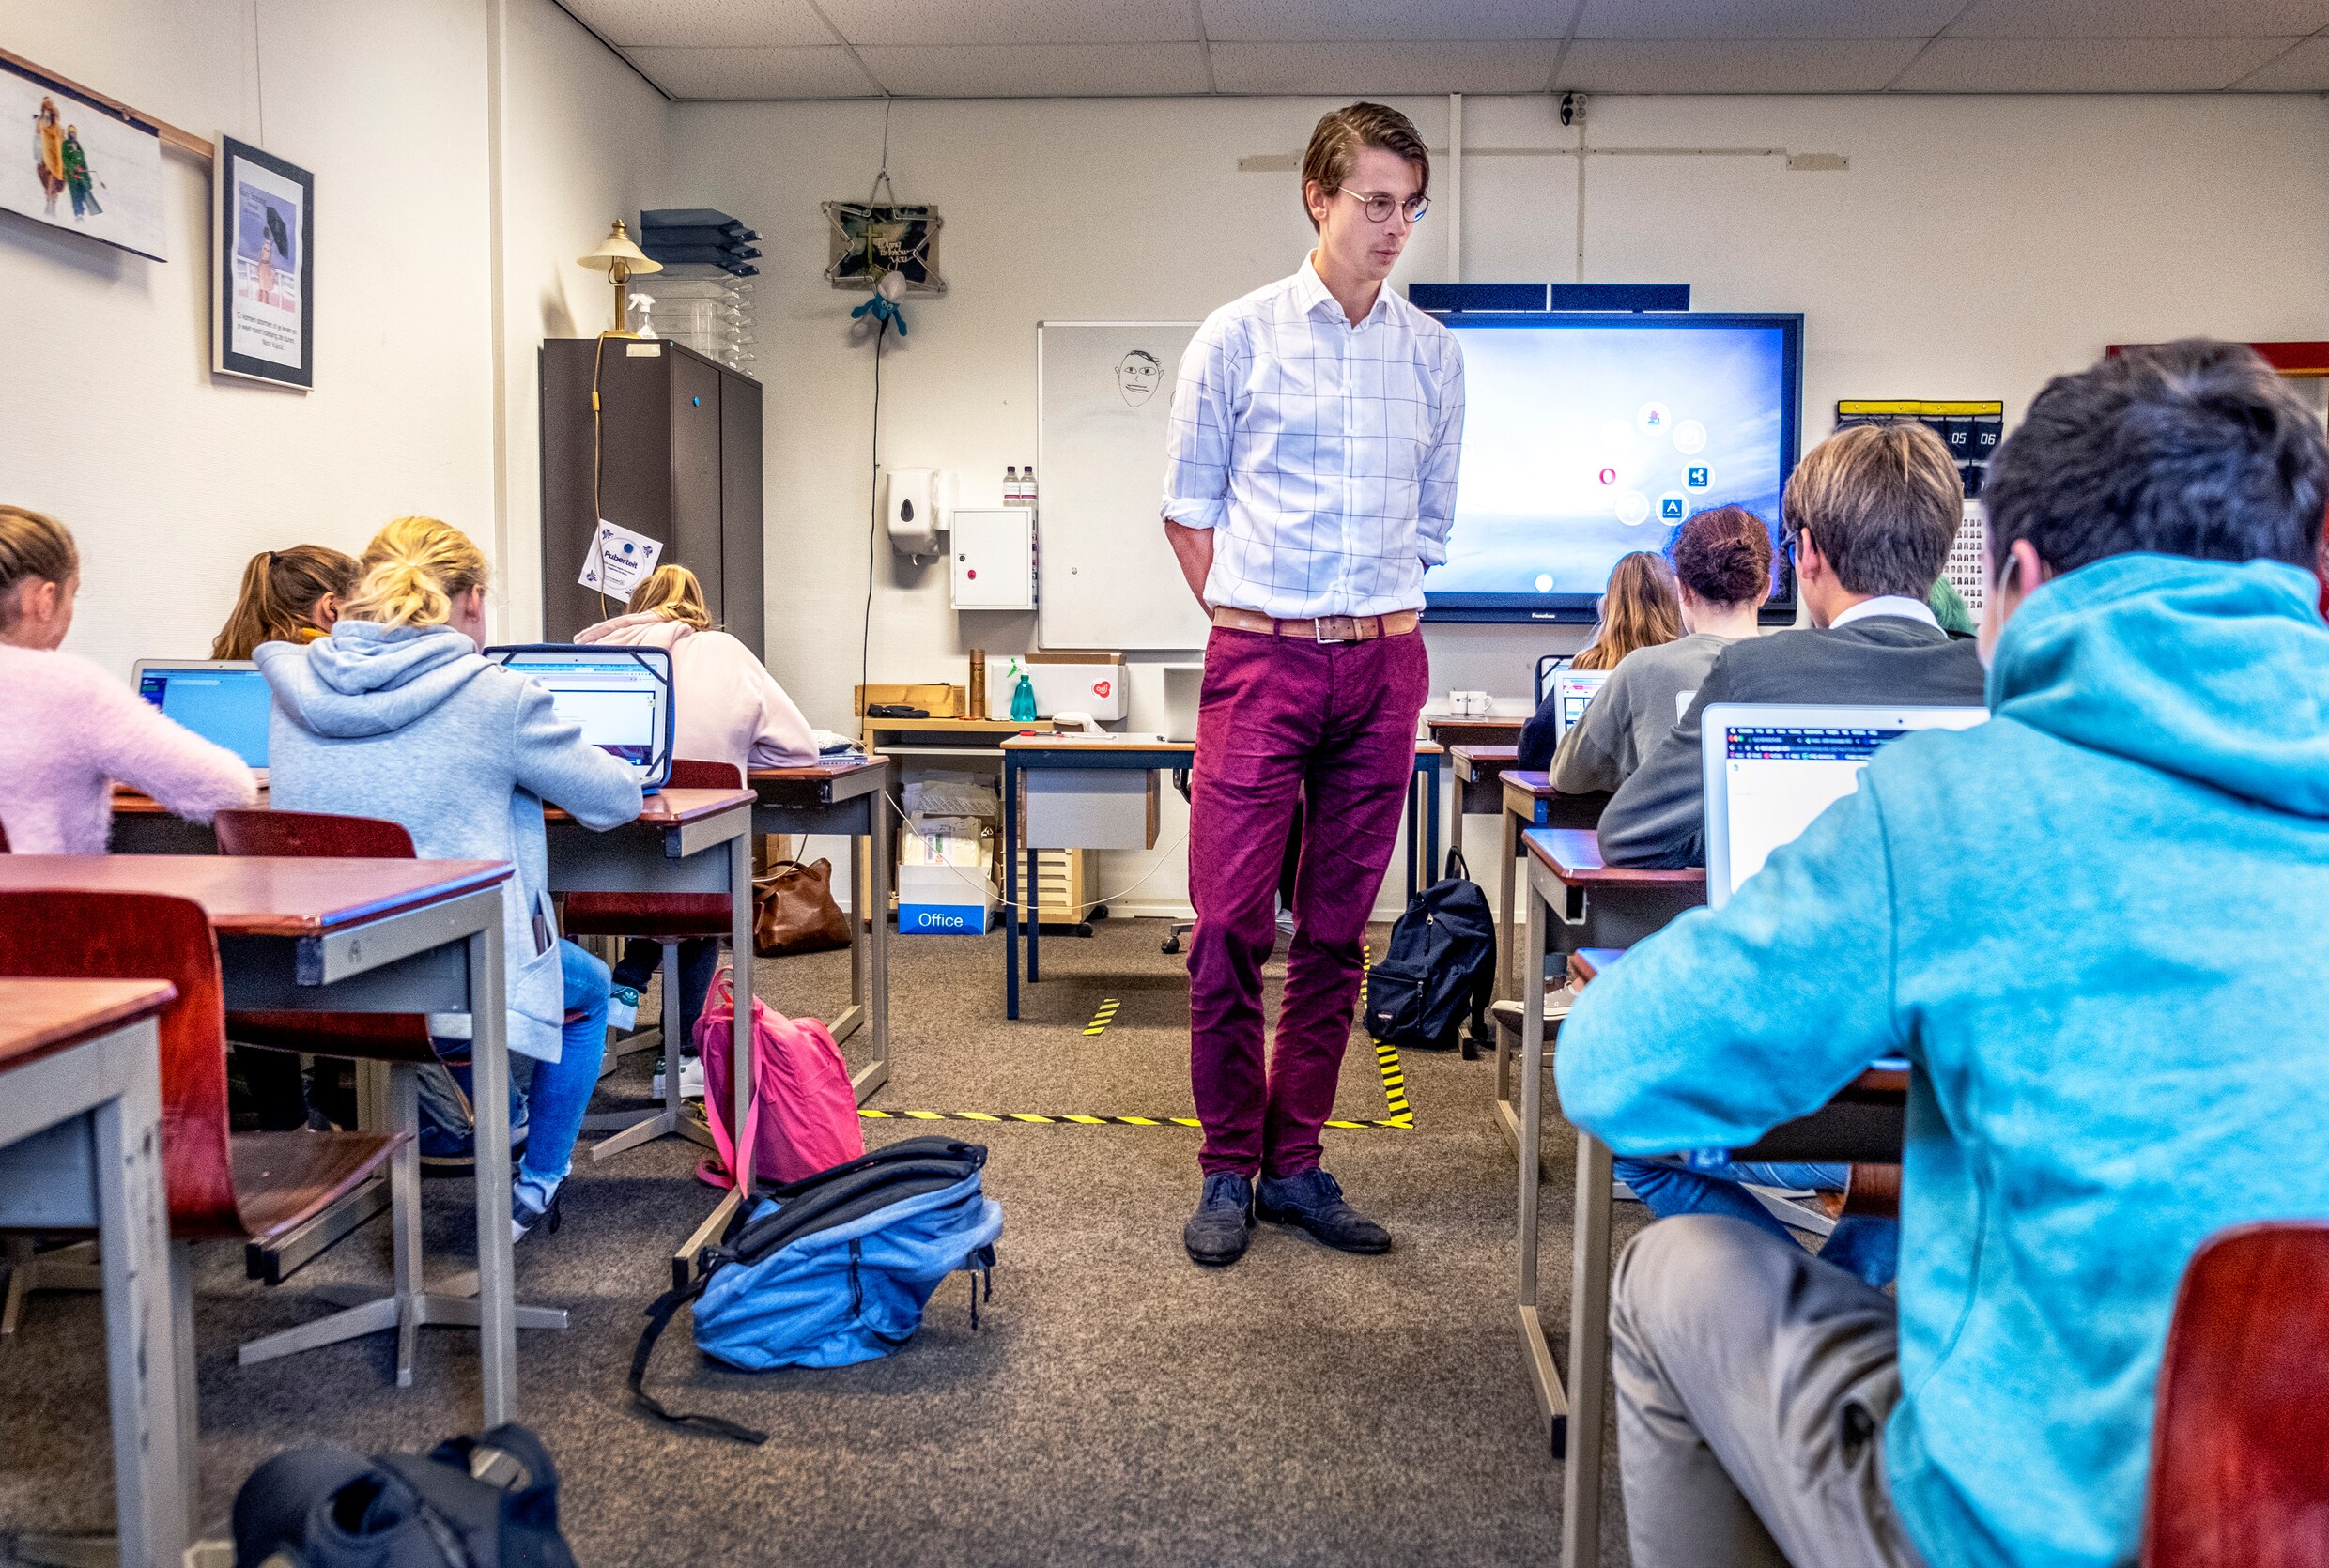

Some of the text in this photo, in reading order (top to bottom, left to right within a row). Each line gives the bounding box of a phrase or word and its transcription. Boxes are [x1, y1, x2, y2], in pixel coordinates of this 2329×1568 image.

[888, 246, 909, 256] know
[1951, 433, 1996, 446] 05 06
[604, 550, 638, 569] Puberteit
[918, 912, 964, 928] Office
